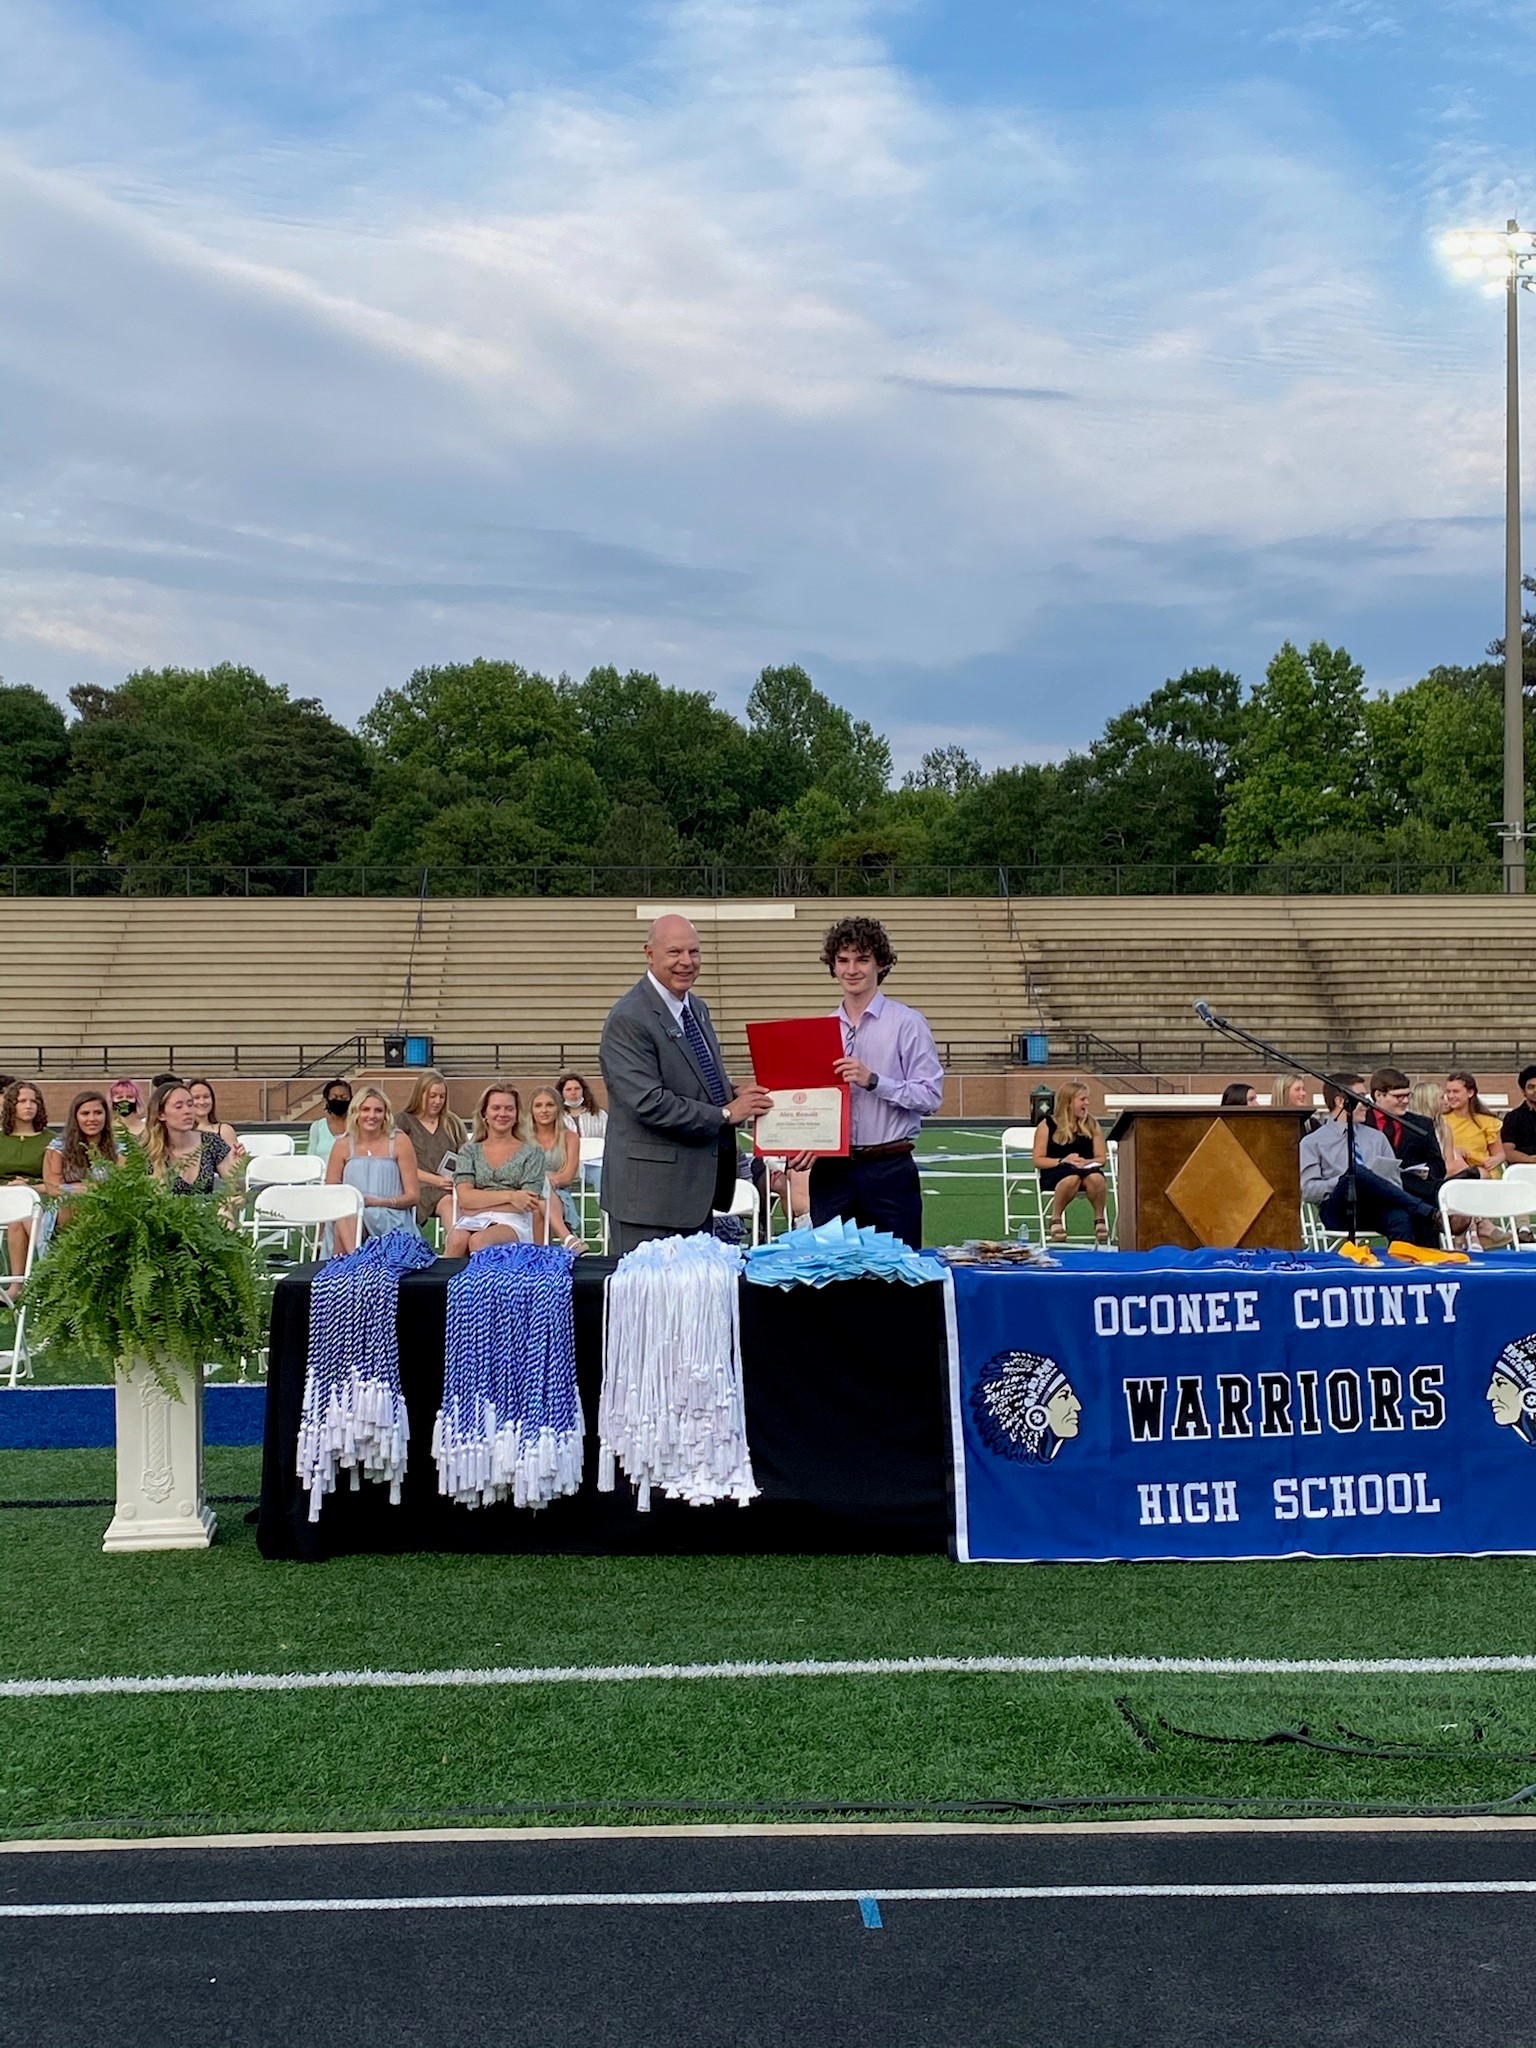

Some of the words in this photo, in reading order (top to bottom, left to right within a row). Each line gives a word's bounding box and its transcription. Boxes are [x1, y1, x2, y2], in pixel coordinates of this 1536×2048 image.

[1094, 1291, 1260, 1336] OCONEE
[1294, 1283, 1460, 1329] COUNTY
[1123, 1365, 1446, 1442] WARRIORS
[1137, 1481, 1239, 1525] HIGH
[1273, 1473, 1440, 1519] SCHOOL
